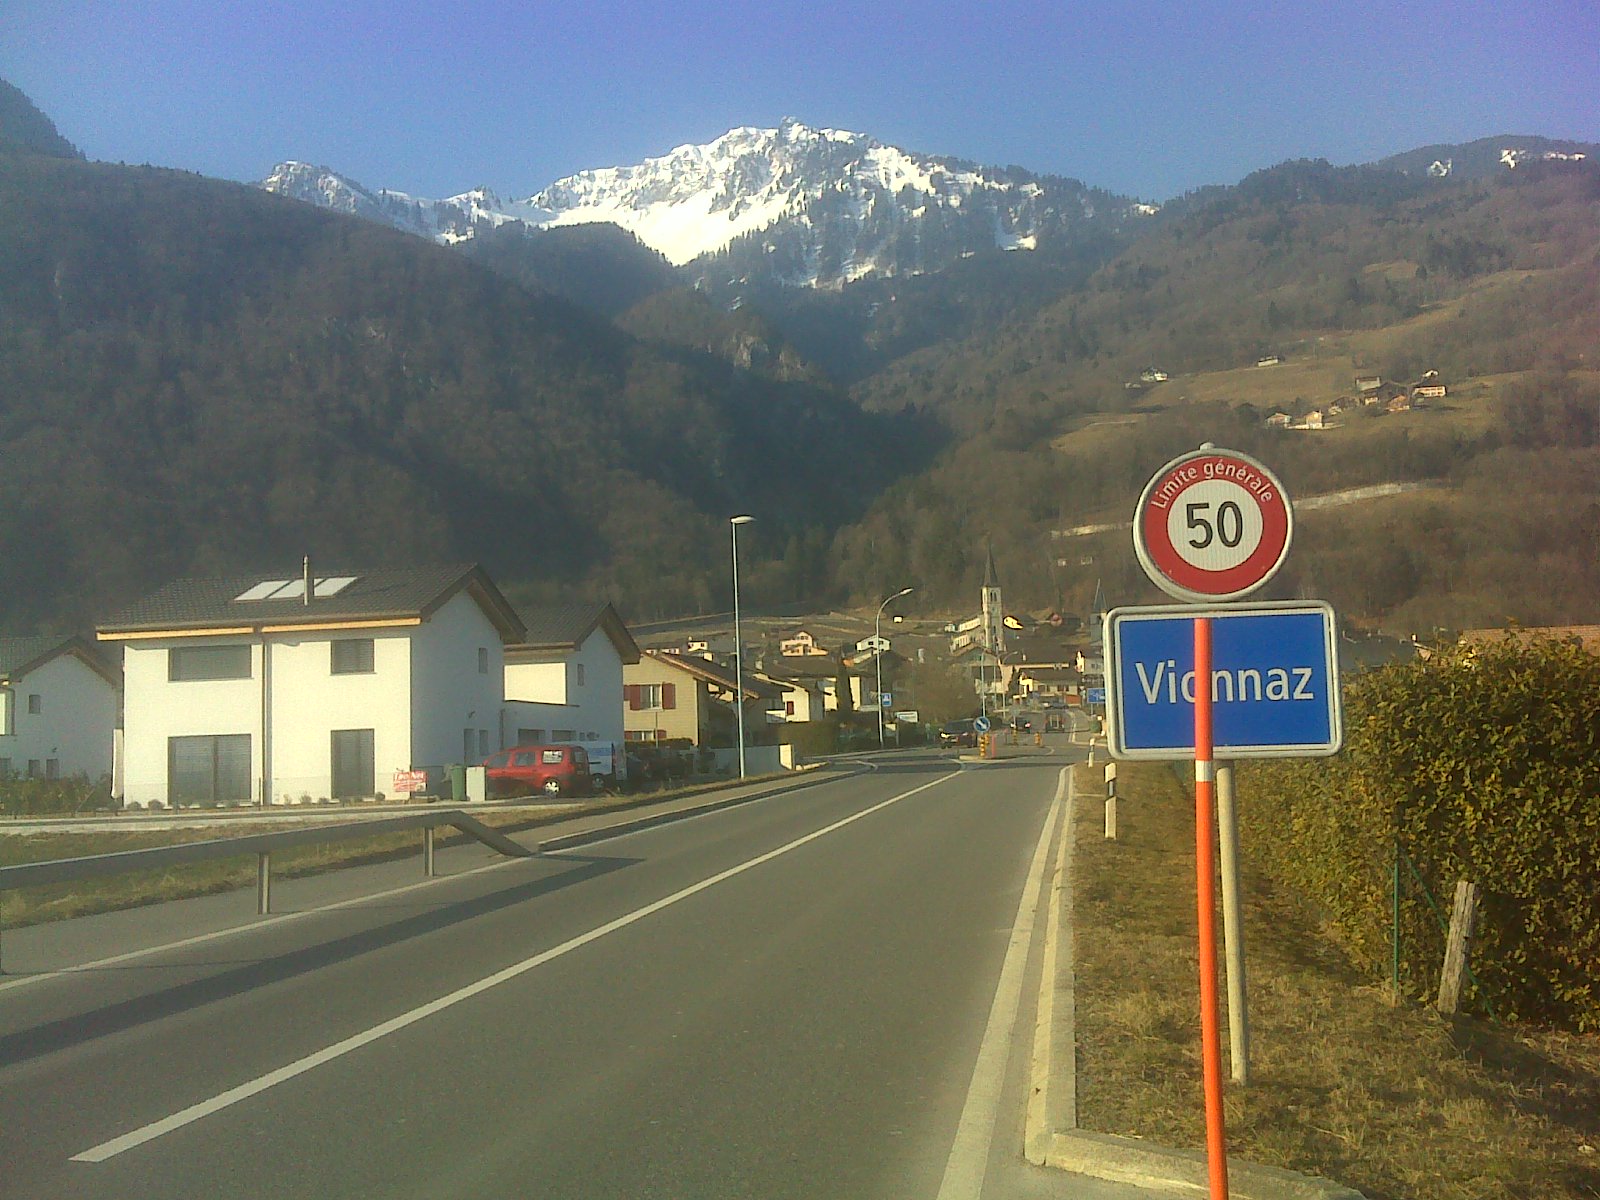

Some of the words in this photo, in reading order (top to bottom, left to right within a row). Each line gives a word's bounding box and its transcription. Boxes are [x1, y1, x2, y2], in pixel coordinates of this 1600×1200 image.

[1151, 467, 1197, 509] Limite
[1203, 459, 1273, 502] générale
[1186, 501, 1243, 548] 50
